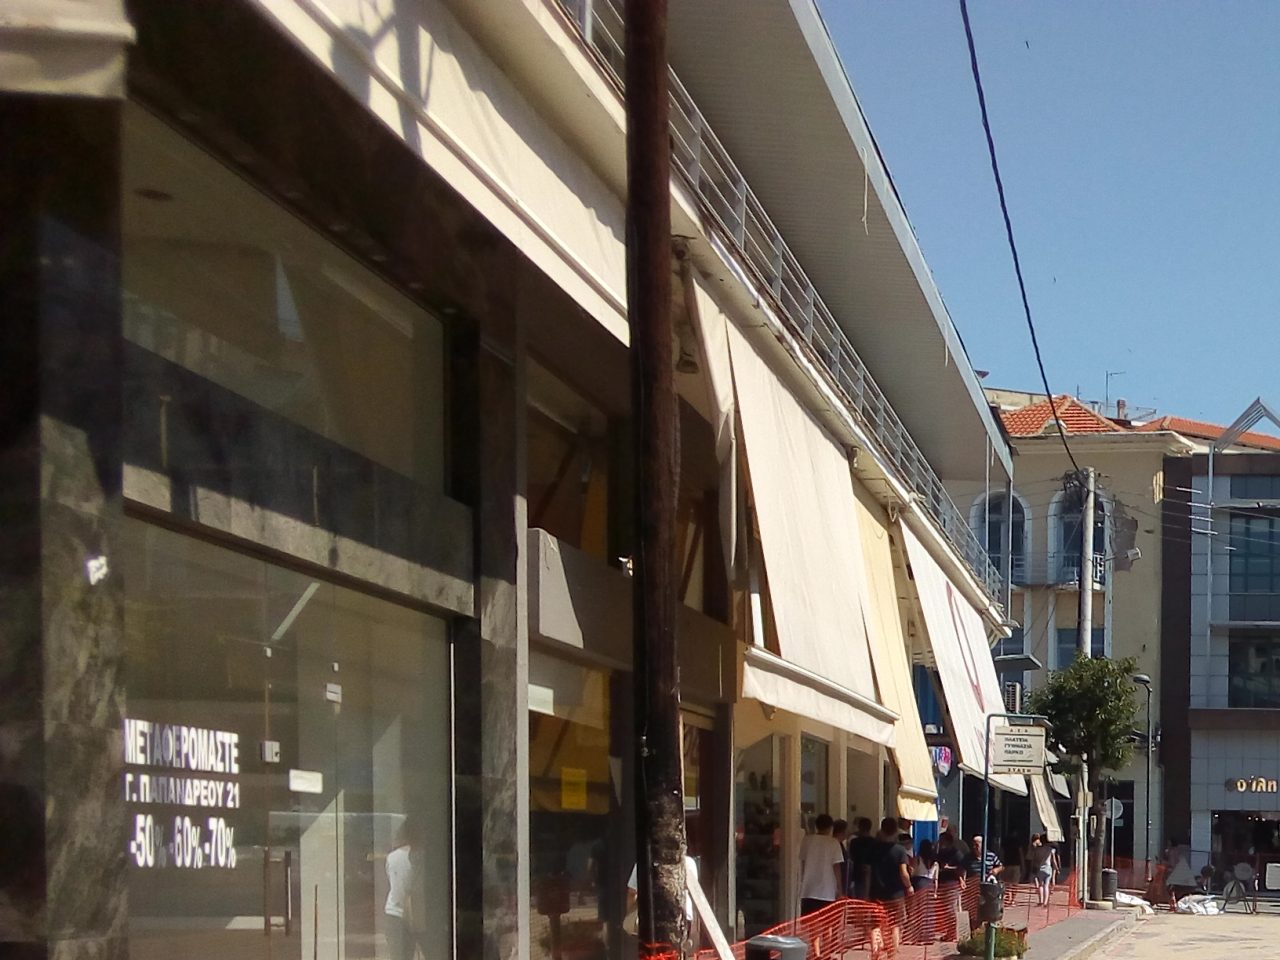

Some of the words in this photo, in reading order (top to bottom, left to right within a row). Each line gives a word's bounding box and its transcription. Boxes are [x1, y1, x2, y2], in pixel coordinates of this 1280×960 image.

[125, 719, 239, 773] ΜΕΤΑΦΕΡΟΜΑΣΤΕ
[140, 775, 224, 806] ΠΑΠΑΝΔΡΕΟΥ
[226, 784, 240, 808] 21
[204, 817, 237, 869] -70%
